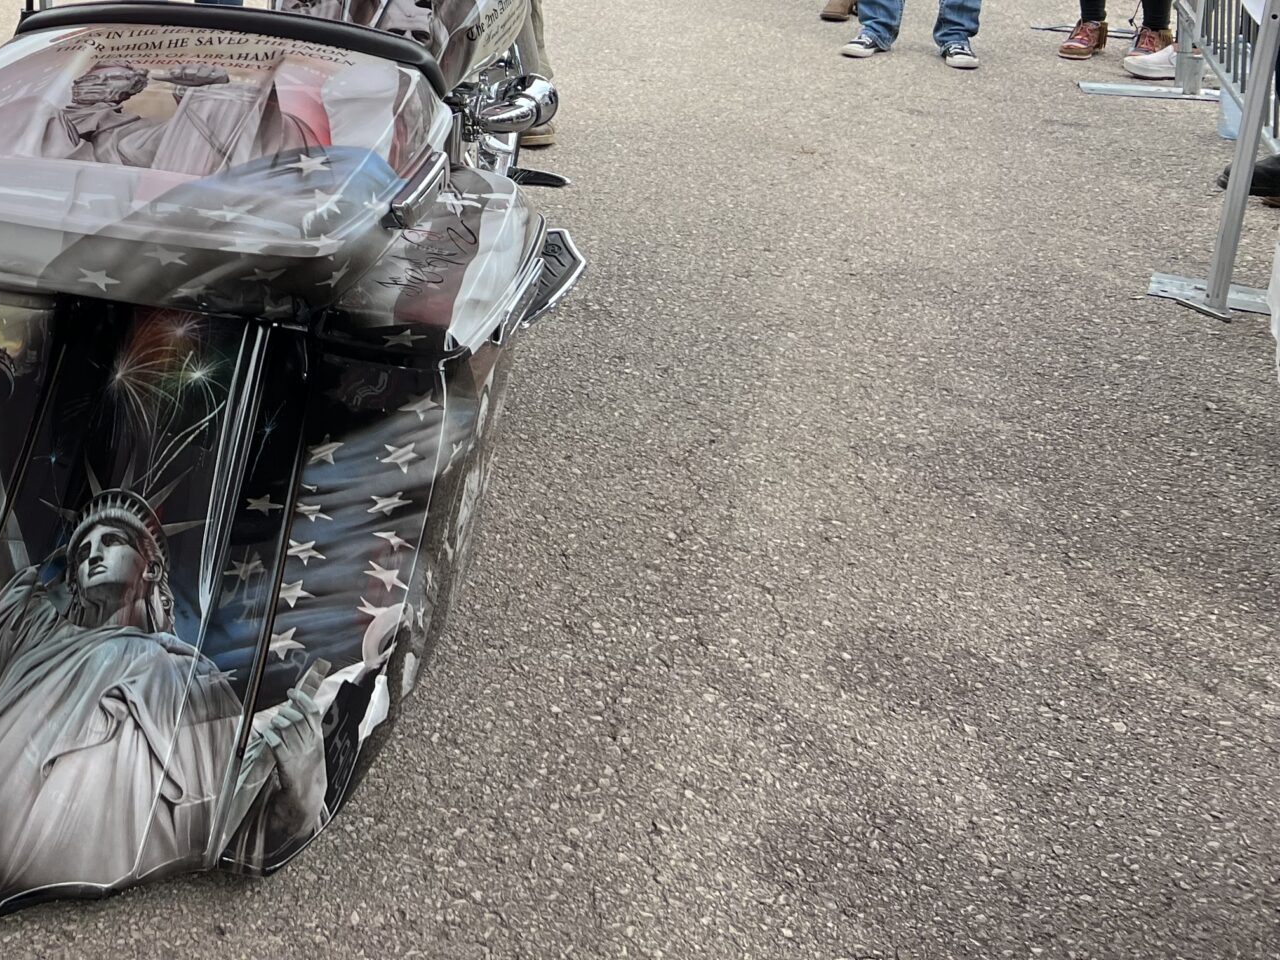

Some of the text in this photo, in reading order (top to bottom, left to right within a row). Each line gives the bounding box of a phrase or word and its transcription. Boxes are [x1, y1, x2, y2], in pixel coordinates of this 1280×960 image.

[105, 31, 123, 40] IN
[129, 28, 159, 38] THE
[465, 22, 485, 41] The
[485, 8, 499, 28] 2nd
[110, 39, 163, 52] WHOM
[166, 38, 189, 50] HE
[194, 36, 249, 47] SAVED
[292, 43, 349, 58] UNION
[90, 52, 162, 60] MEMORY
[194, 51, 276, 63] ABRAHAM
[280, 48, 357, 68] LINCOLN
